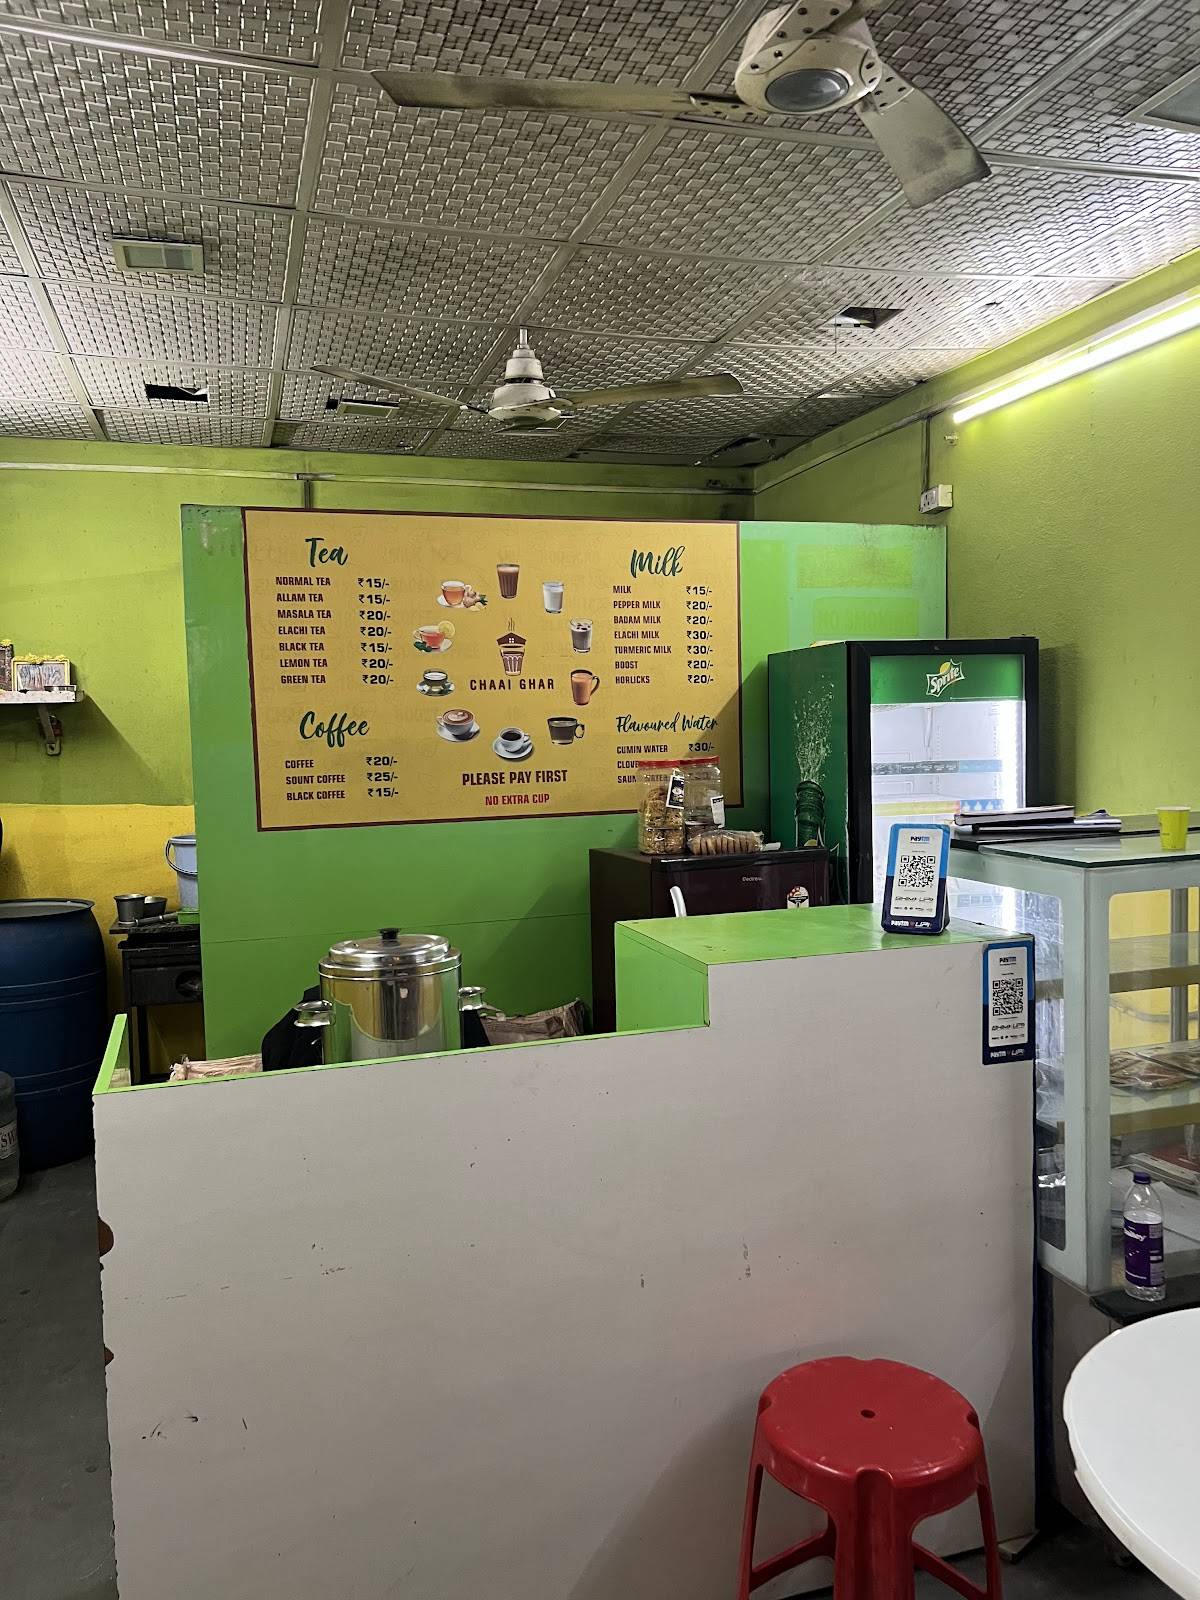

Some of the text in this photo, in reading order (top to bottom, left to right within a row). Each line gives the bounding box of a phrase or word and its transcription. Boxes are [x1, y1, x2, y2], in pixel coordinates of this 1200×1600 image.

[304, 537, 348, 567] Tea
[630, 545, 685, 578] Milk
[276, 577, 389, 588] NORMAL TEA ₹15/-
[686, 586, 712, 596] ₹15/-
[276, 593, 390, 605] ALLAM TEA ₹15/-
[613, 601, 712, 611] PEPPER MILK ₹20/-
[277, 610, 391, 621] MASALA TEA ₹20/-
[613, 616, 712, 626] BADAM MILK ₹20/-
[278, 626, 392, 637] ELACHI TEA ₹20/-
[614, 631, 712, 641] ELACHI MILK ₹30/-
[279, 642, 392, 653] BLACK TEA ₹15/-
[614, 645, 713, 656] TURMERIC MILK ₹30/-
[280, 659, 393, 669] LEMON TEA ₹20/-
[615, 660, 713, 670] BOOST ₹20/-
[281, 675, 394, 685] GREEN TEA ₹20/-
[470, 679, 554, 690] CHAAI GHAR
[615, 675, 714, 685] HORLICKS ₹20/-
[930, 666, 960, 693] Sprite
[616, 712, 718, 733] Flavoured Water
[300, 711, 369, 748] Coffee
[617, 742, 715, 754] CUMIN WATER ₹30/-
[285, 756, 397, 769] COFFEE ₹20/-
[286, 772, 398, 785] SOUNT COFFEE ₹25/-
[462, 770, 568, 785] PLEASE PAY FIRST
[287, 787, 399, 800] BLACK COFFEE ₹15/-
[485, 794, 549, 805] NO EXTRA CUP
